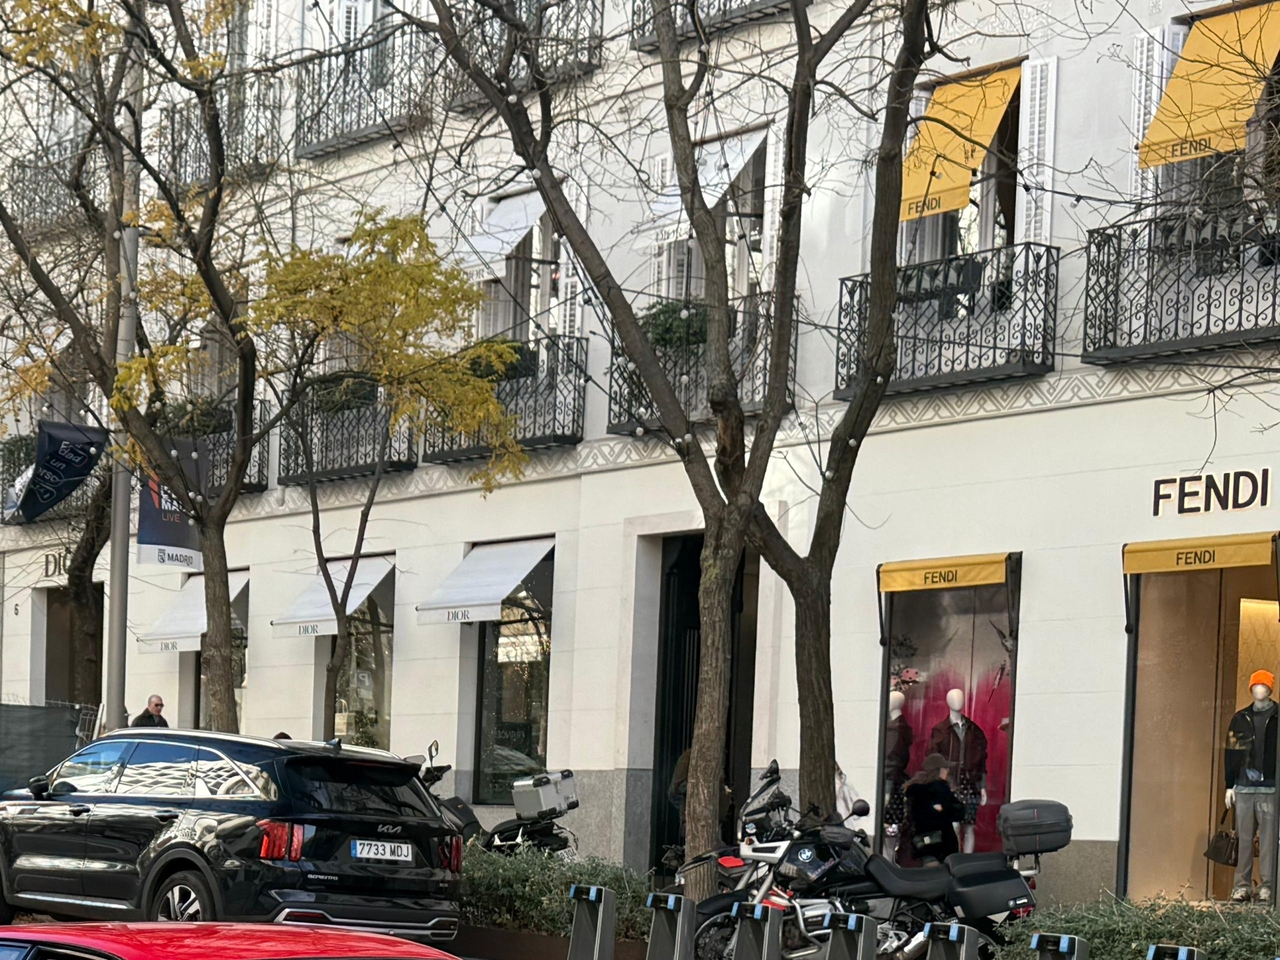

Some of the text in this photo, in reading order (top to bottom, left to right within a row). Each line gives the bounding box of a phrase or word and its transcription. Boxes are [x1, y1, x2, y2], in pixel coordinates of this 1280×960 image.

[1172, 136, 1211, 158] FENDI
[908, 196, 941, 215] FENDI
[1153, 468, 1269, 516] FENDI
[162, 512, 180, 523] LIVE
[167, 552, 194, 566] MADRID
[1176, 550, 1216, 566] FENDI
[923, 569, 958, 585] FENDI
[447, 610, 470, 622] DIOR
[298, 624, 319, 636] DIOR
[160, 641, 178, 651] DIOR
[358, 842, 410, 858] 7733 MDJ
